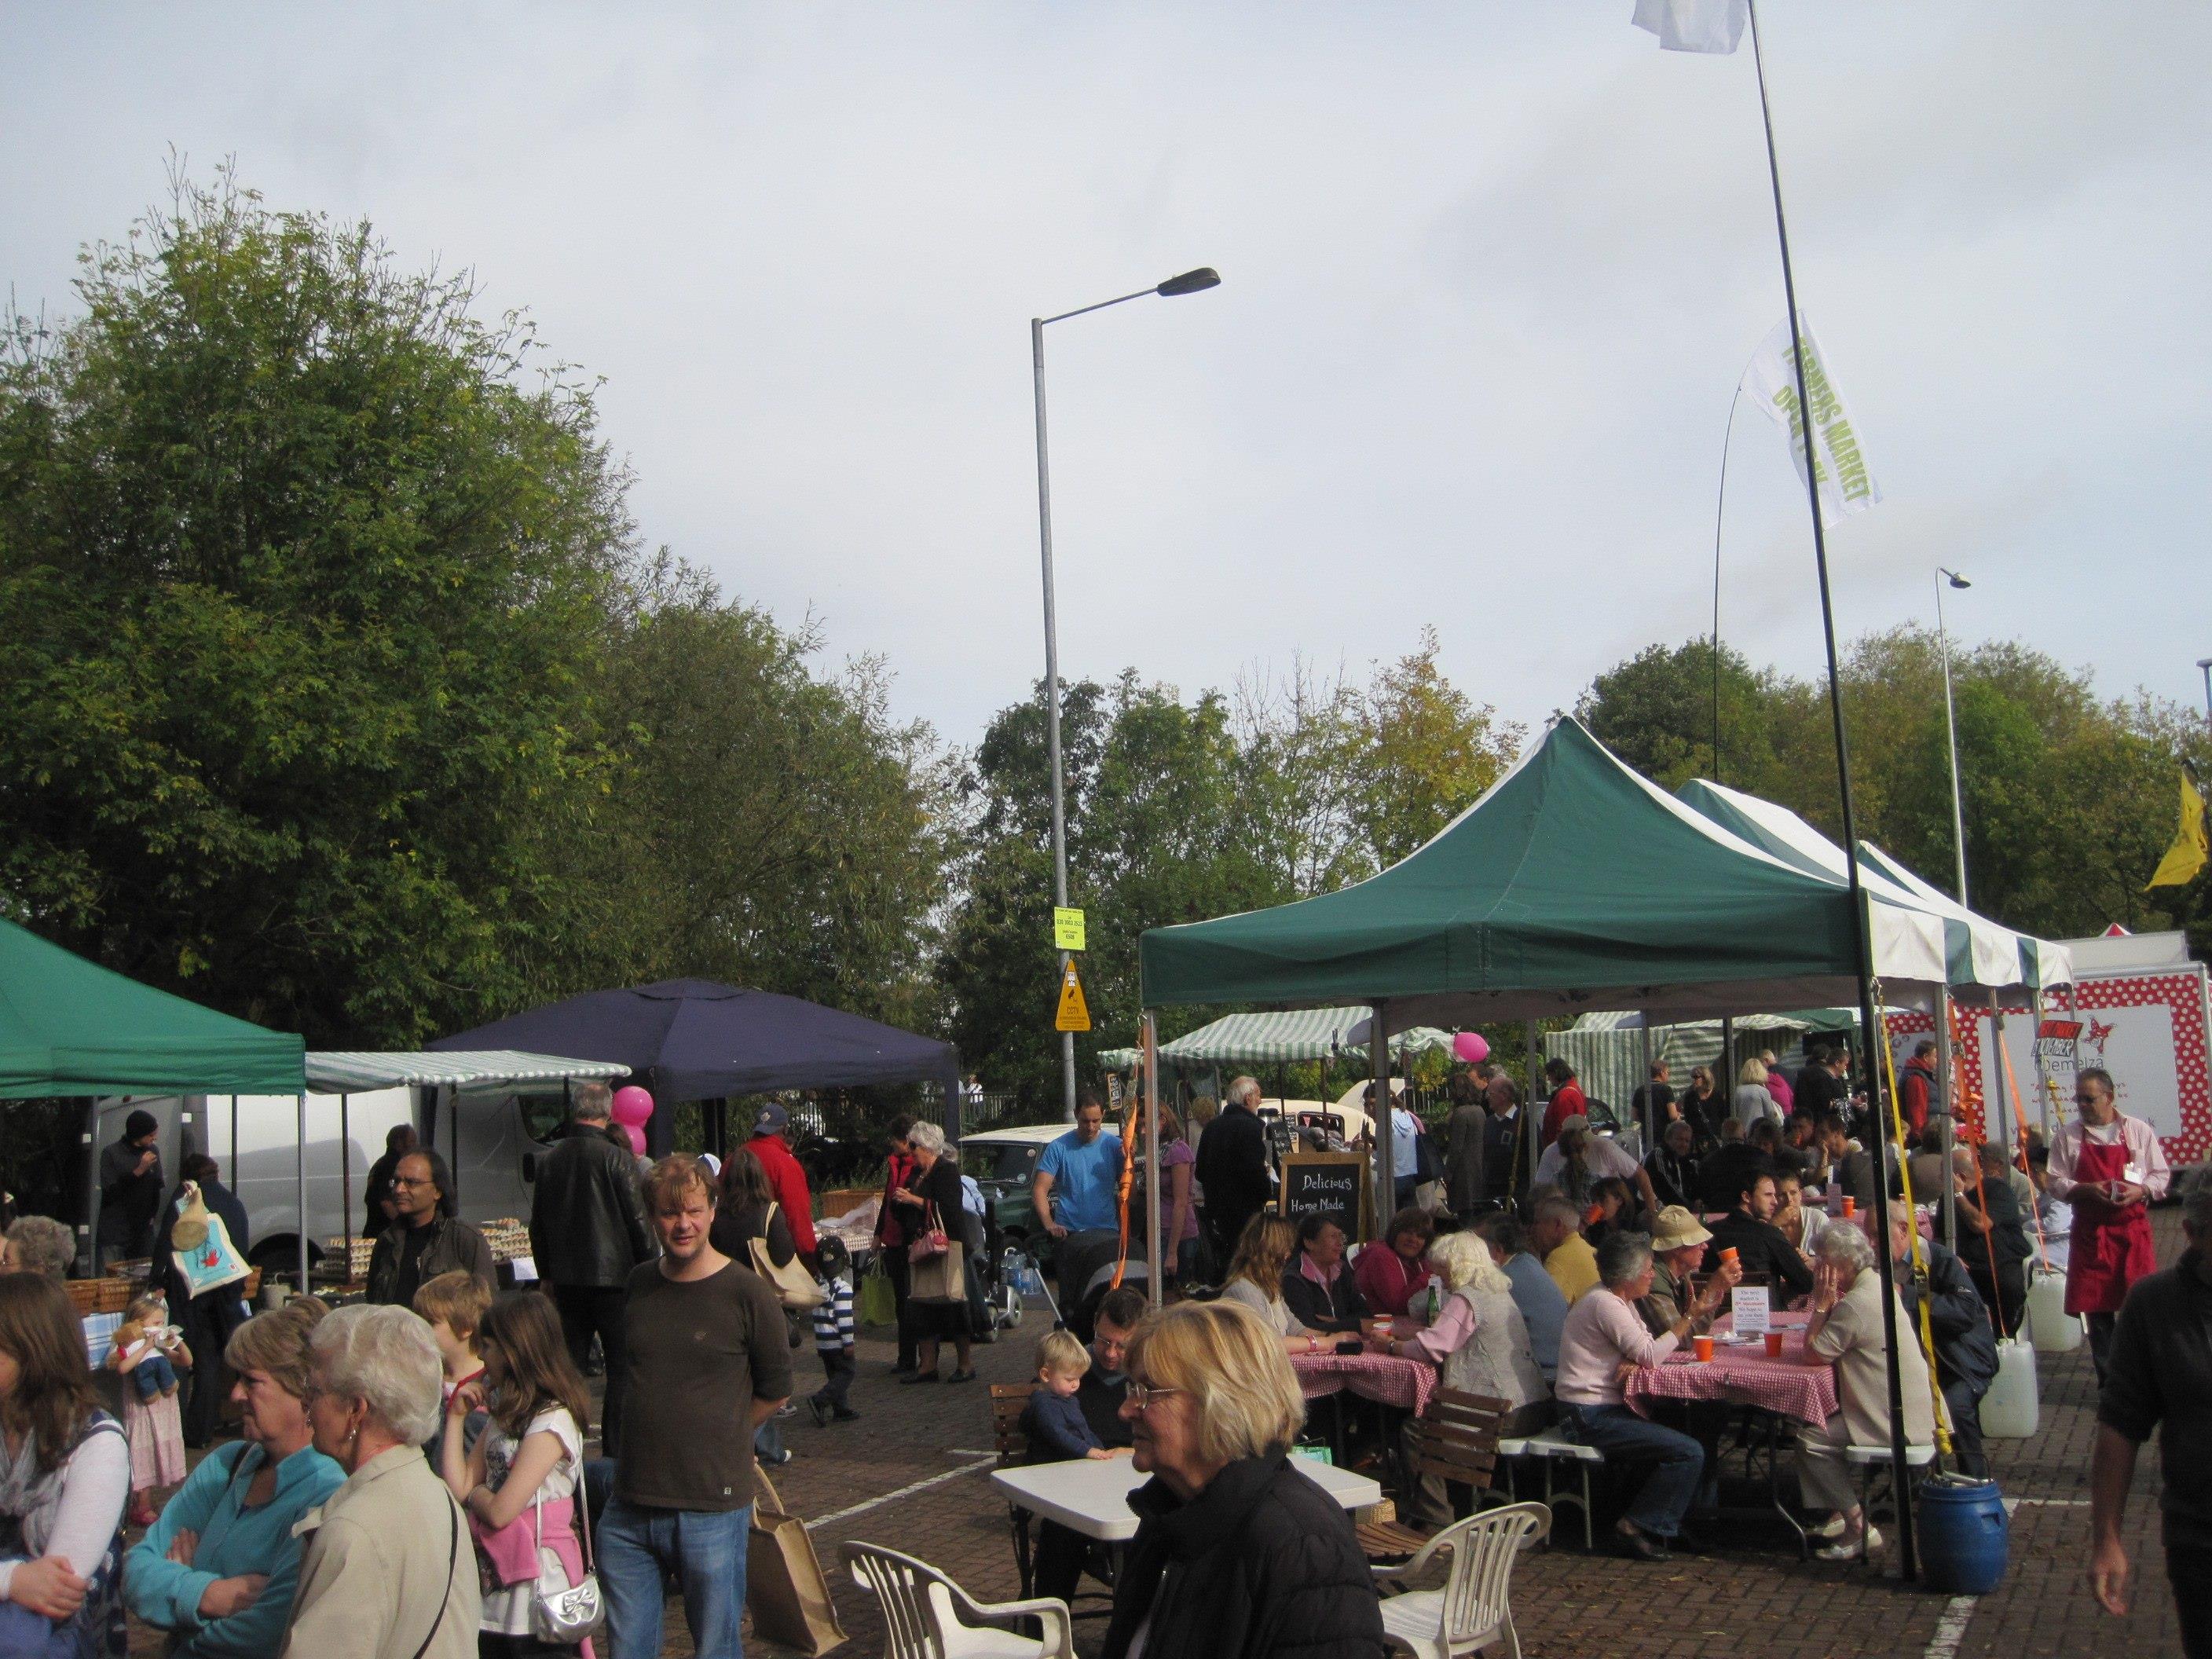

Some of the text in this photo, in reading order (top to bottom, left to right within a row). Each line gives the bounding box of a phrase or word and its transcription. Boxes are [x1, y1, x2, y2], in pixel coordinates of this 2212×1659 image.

[1821, 419, 1871, 503] MARKET
[1302, 1173, 1352, 1191] Delicious
[1291, 1196, 1345, 1212] Home Made
